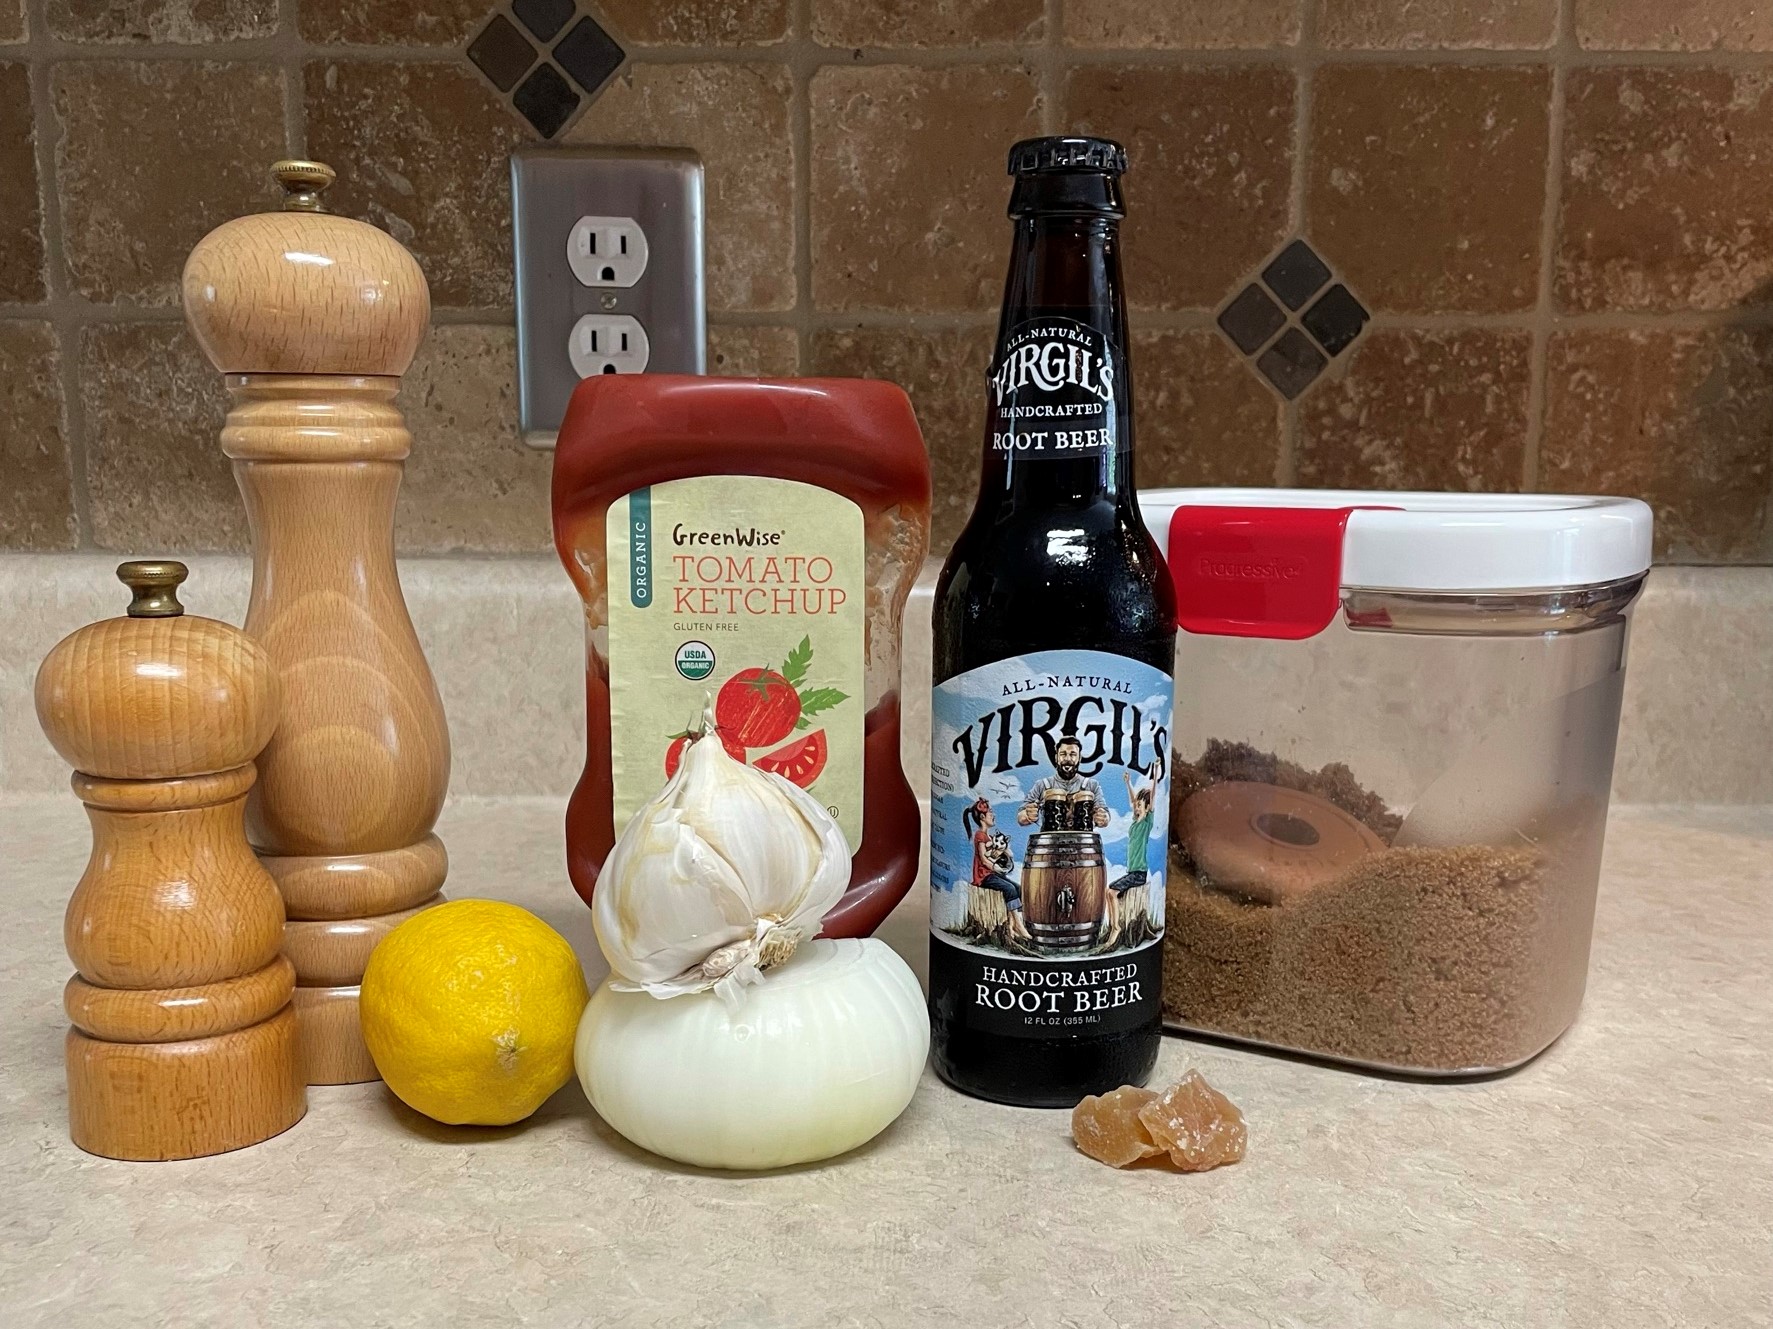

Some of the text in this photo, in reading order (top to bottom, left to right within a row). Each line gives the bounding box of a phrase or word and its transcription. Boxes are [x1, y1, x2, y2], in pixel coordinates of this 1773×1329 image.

[1006, 327, 1092, 352] ALL-NATURAL
[992, 341, 1114, 407] VIRGIL'S
[1000, 402, 1103, 418] HANDCRAFTED
[992, 428, 1113, 450] ROOT BEER
[635, 522, 647, 599] ORGANIC
[672, 555, 834, 584] TOMATO
[672, 587, 847, 615] KETCHUP
[673, 622, 739, 632] GLUTEN FREE
[684, 650, 707, 659] USDA
[1002, 675, 1133, 697] ALL-NATURAL
[952, 695, 1168, 789] VIRGIL'S
[982, 963, 1138, 988] HANDCRAFTED
[975, 981, 1143, 1013] ROOT BEER
[1024, 1016, 1033, 1025] 12
[1035, 1017, 1046, 1026] FL
[1048, 1017, 1061, 1026] OZ
[1085, 1014, 1101, 1025] ML)
